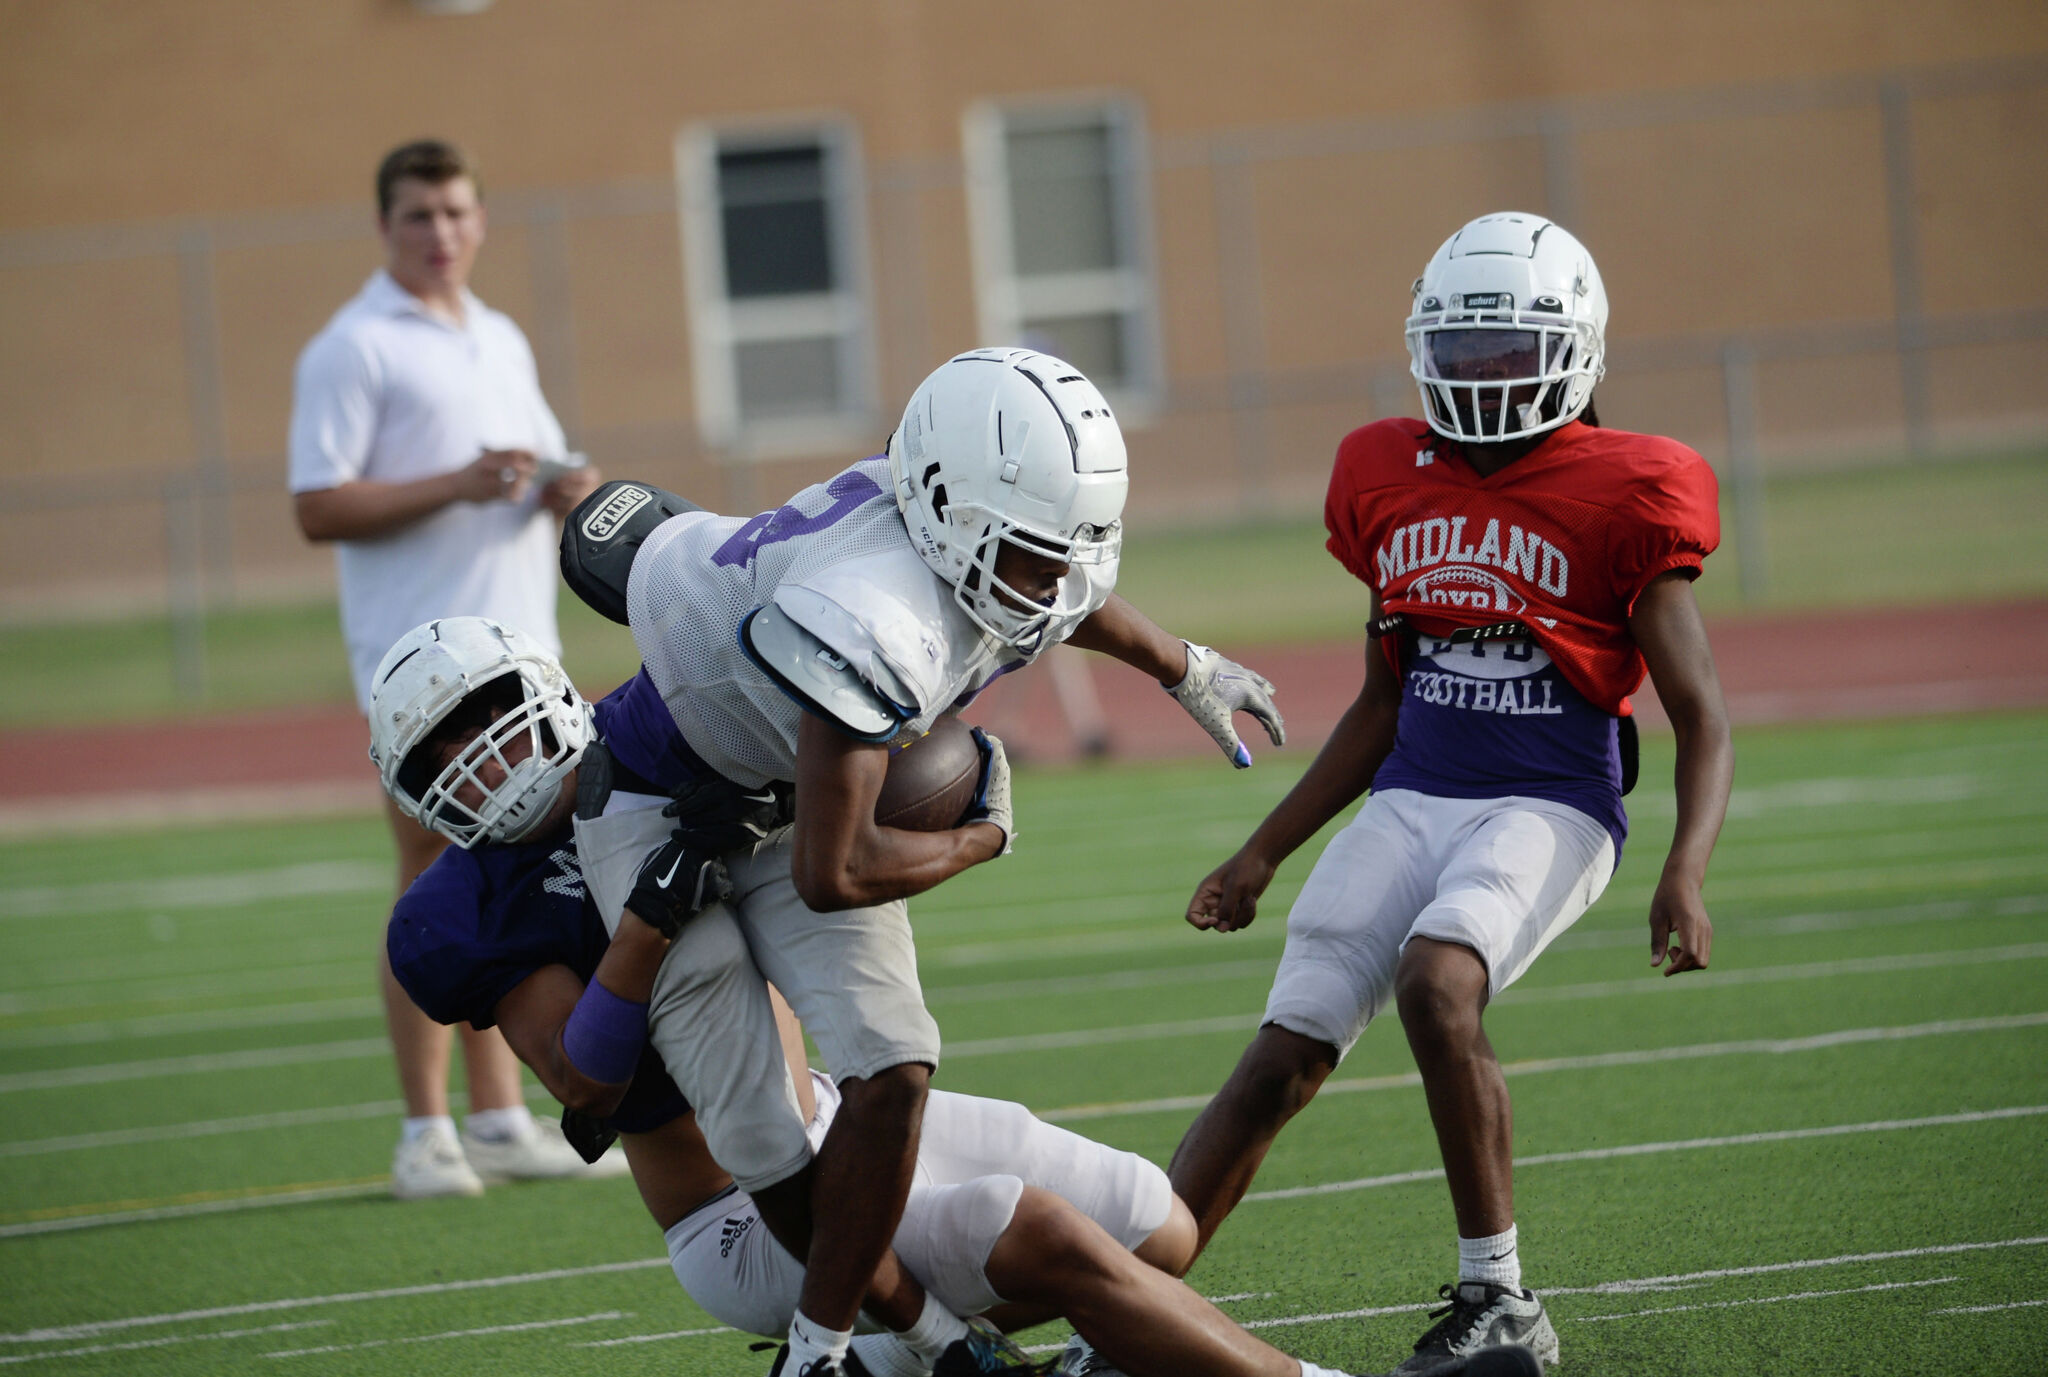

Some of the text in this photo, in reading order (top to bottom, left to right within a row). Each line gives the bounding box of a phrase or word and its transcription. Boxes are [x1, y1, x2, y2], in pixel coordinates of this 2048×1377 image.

[1468, 295, 1497, 306] schutt
[588, 487, 647, 536] BATTLE
[1376, 516, 1569, 598] MIDLAND
[1410, 670, 1563, 715] FOOTBALL
[721, 1216, 755, 1258] adidas
